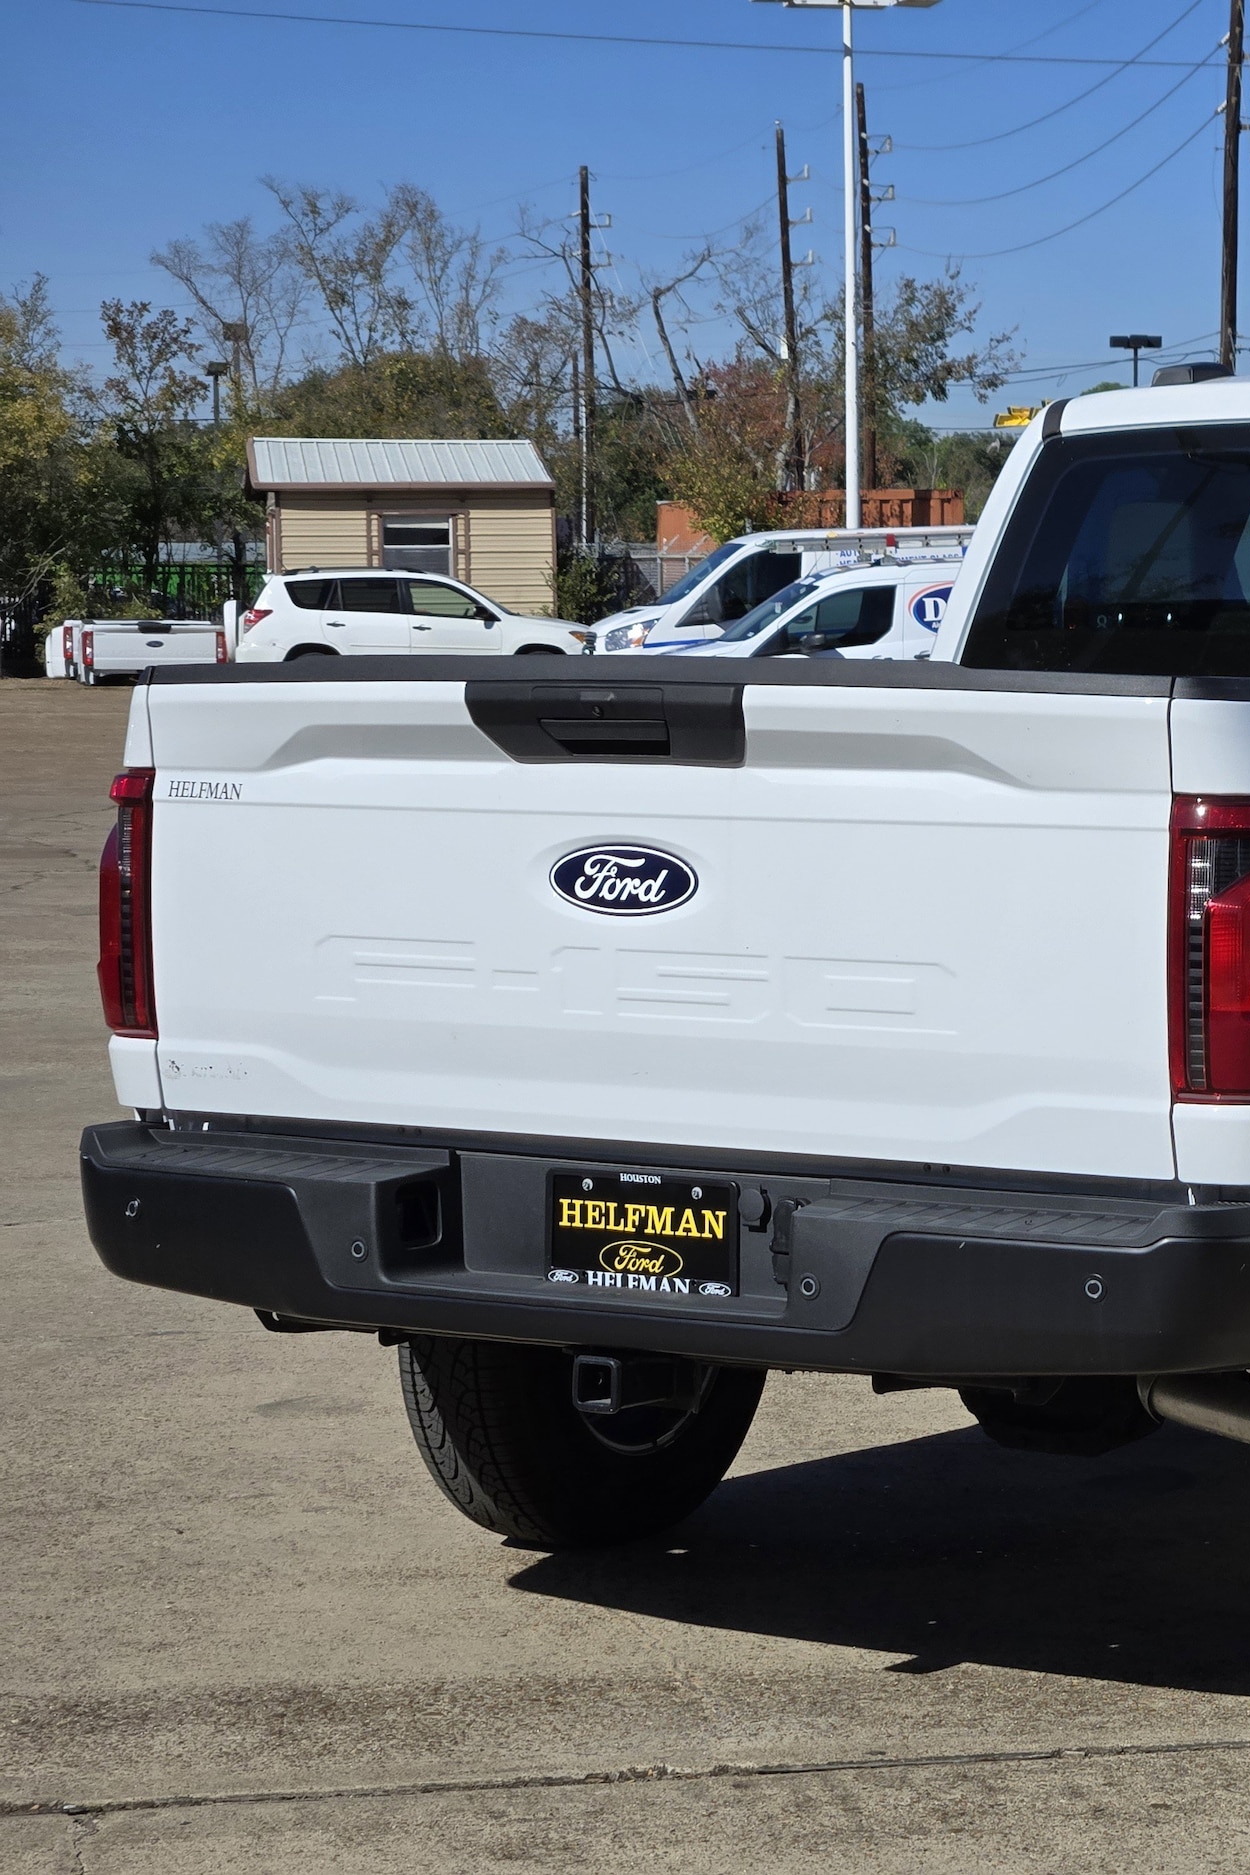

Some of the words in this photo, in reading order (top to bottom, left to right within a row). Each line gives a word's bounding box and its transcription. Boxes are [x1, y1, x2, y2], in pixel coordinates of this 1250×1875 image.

[167, 780, 243, 802] HELFMAN
[573, 853, 671, 906] Ford
[620, 1173, 661, 1184] HOUSTON
[559, 1199, 727, 1239] HELFMAN
[614, 1244, 665, 1274] Ford
[586, 1270, 691, 1294] HELFMAN
